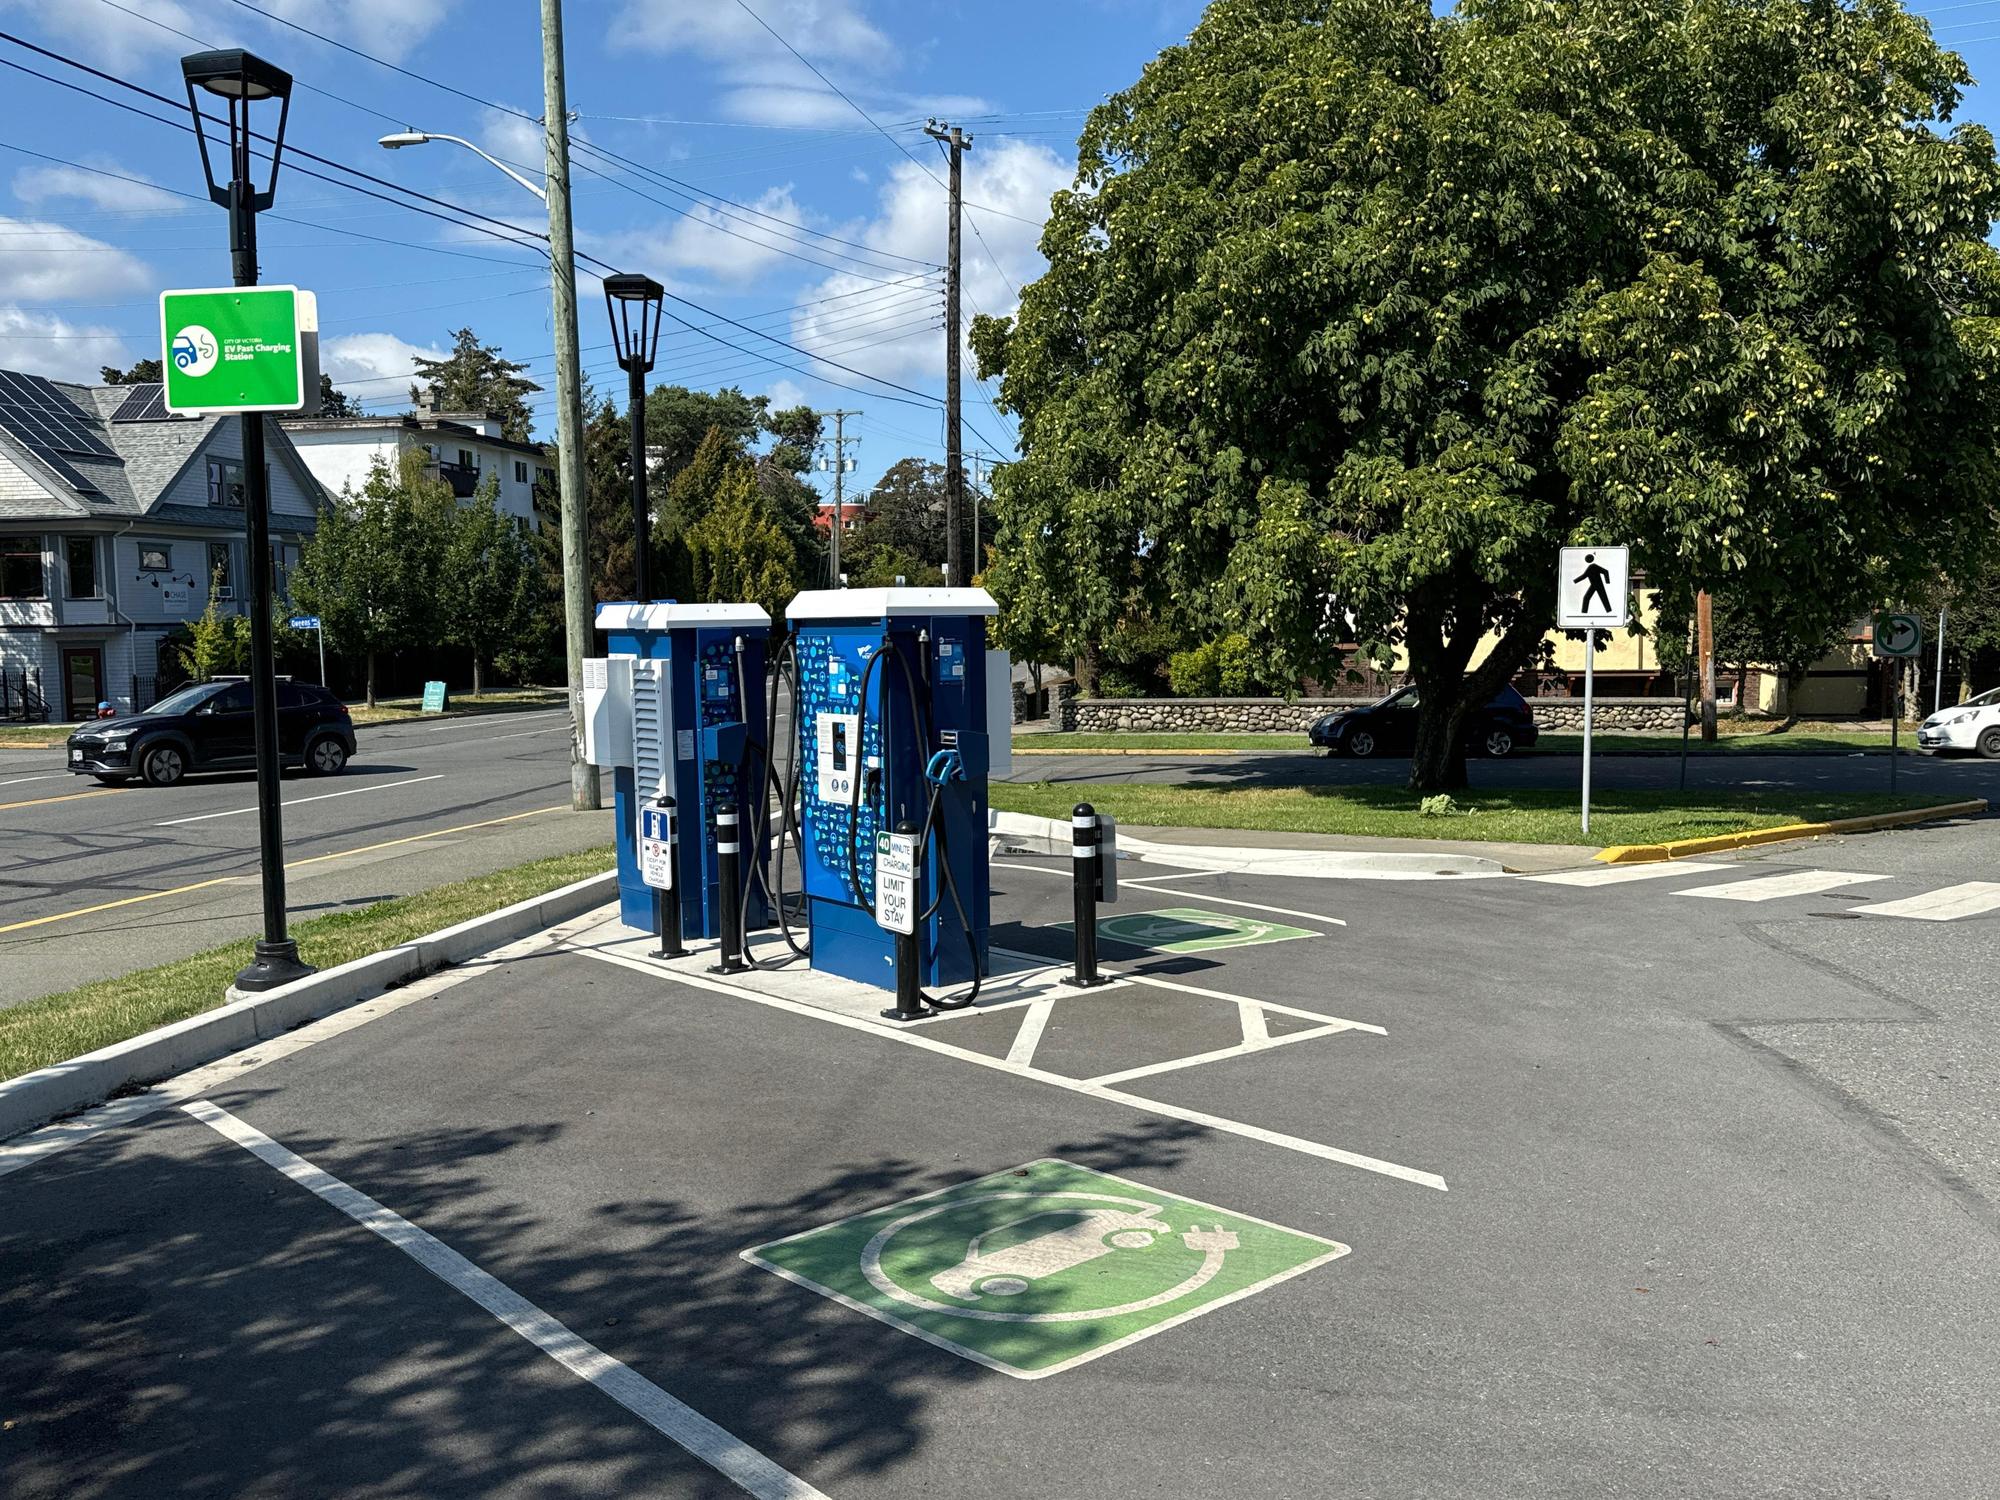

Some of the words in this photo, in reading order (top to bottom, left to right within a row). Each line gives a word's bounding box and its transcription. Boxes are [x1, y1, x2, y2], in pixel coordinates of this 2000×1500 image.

[255, 342, 291, 353] Charging
[224, 352, 254, 361] Station
[878, 838, 890, 851] 40
[892, 842, 910, 855] MINUTE
[883, 858, 910, 872] CHARGING
[883, 876, 905, 892] LIMIT
[882, 892, 906, 909] YOUR
[884, 908, 904, 926] STAY
